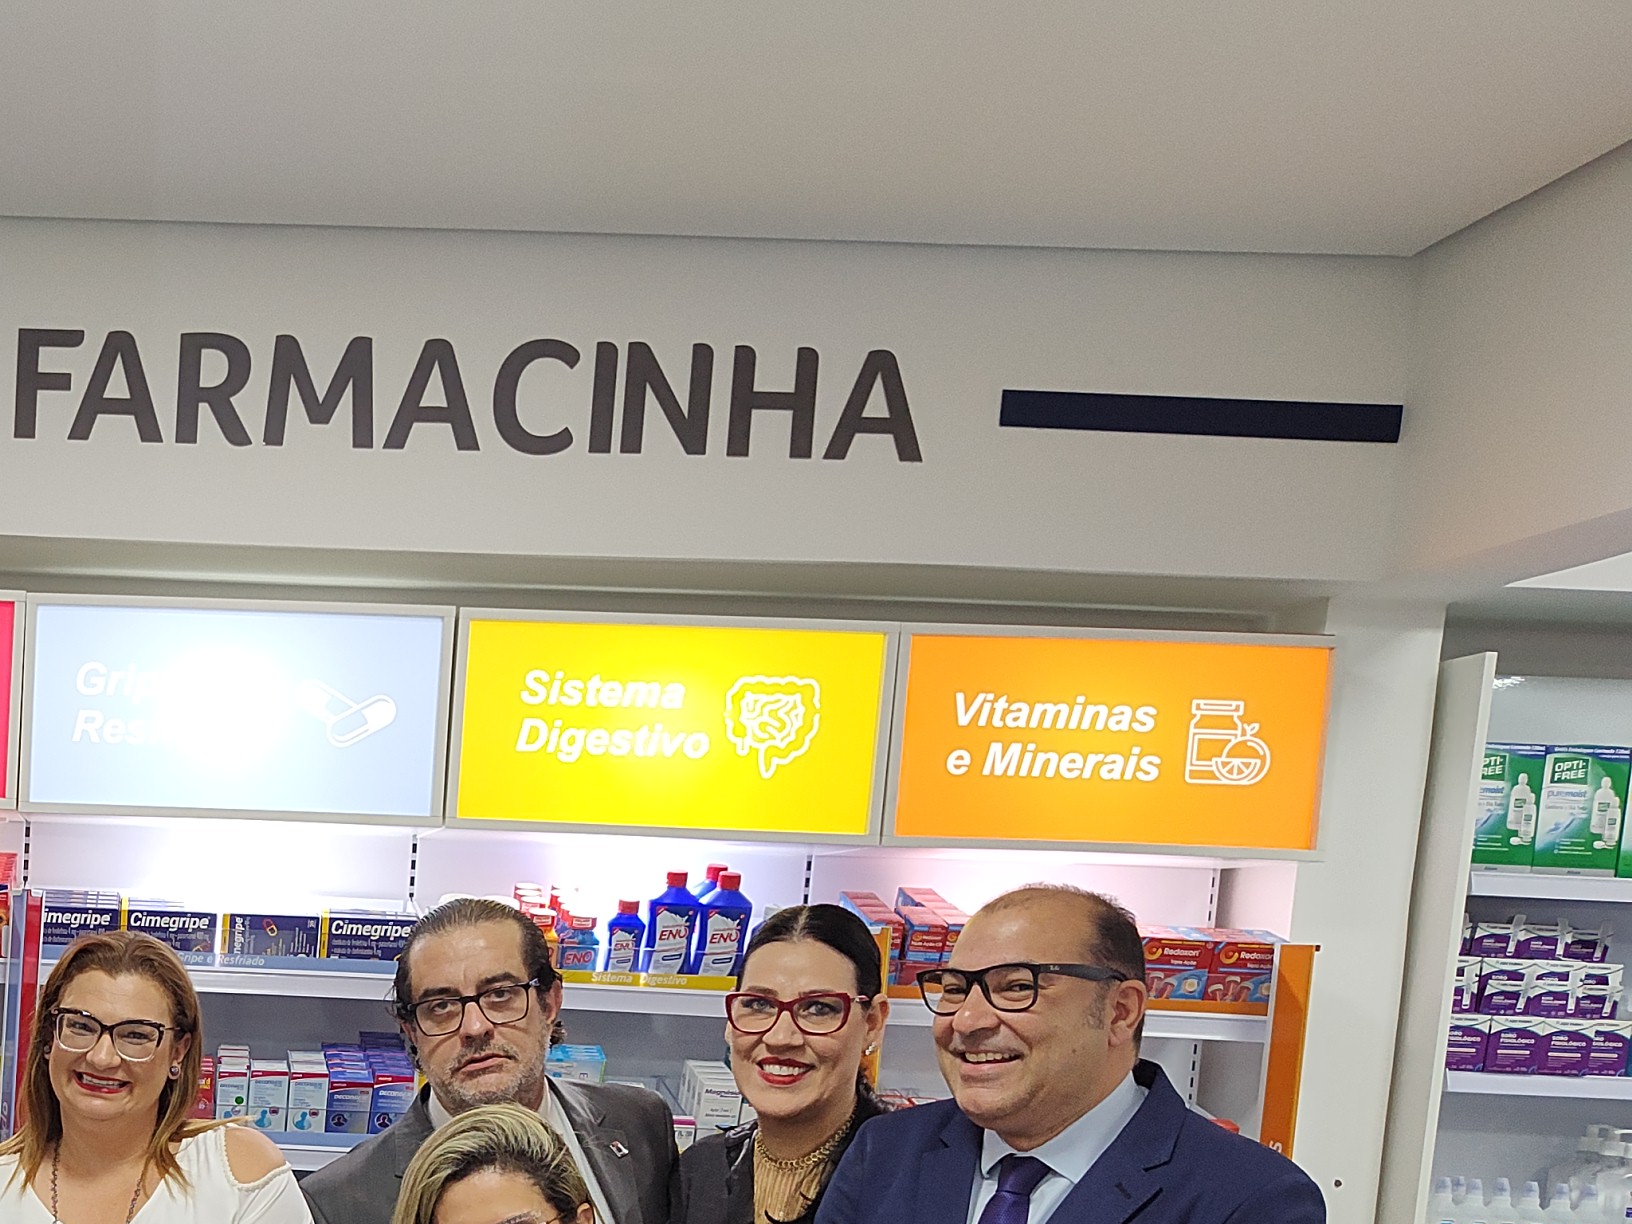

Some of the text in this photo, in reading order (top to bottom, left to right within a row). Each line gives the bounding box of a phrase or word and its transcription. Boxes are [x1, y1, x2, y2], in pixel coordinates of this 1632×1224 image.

[13, 328, 923, 462] FARMACINHA
[520, 670, 686, 710] Sistema
[954, 693, 1157, 733] Vitaminas
[515, 718, 710, 763] Digestivo
[946, 742, 1161, 784] e Minerais
[1555, 760, 1586, 772] OPTI-
[1554, 770, 1586, 782] FREE
[1546, 790, 1588, 799] puremoist
[130, 911, 210, 930] Cimegripe
[331, 920, 411, 941] Cimegripe
[658, 927, 690, 941] ENO
[709, 930, 740, 944] ENO
[563, 951, 593, 965] ENO
[1164, 947, 1200, 957] Redoxon
[206, 954, 265, 966] e Resfriado
[591, 972, 687, 985] Sistema Digestivo
